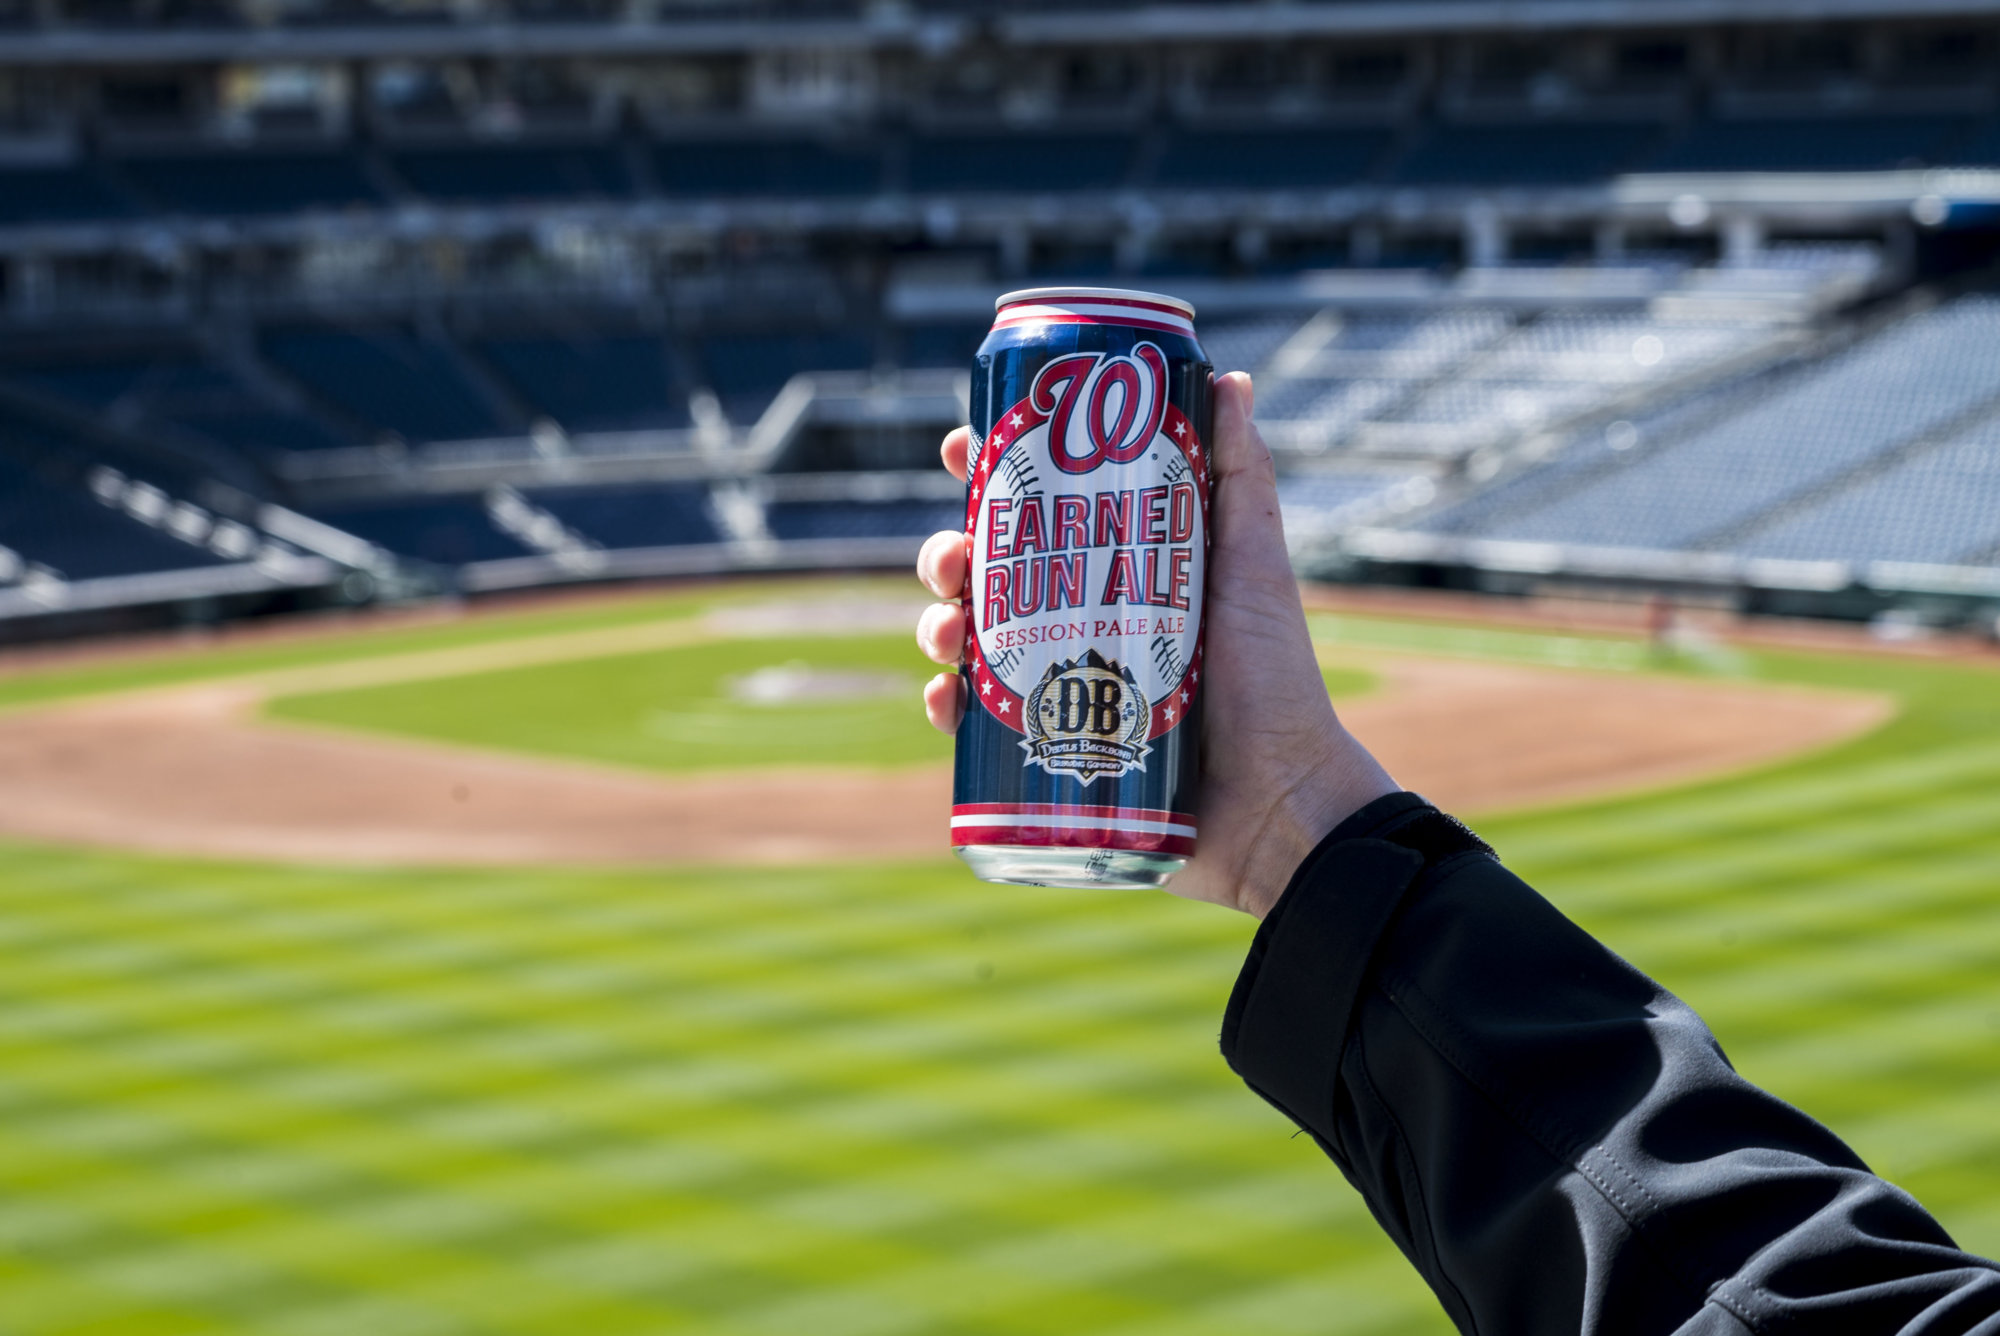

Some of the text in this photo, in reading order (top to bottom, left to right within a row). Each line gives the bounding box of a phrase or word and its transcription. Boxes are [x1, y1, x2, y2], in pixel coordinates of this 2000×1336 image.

[1031, 342, 1168, 475] W
[987, 482, 1194, 562] EARNED
[983, 548, 1192, 632] RUN ALE
[995, 617, 1185, 650] SESSION PALE ALE
[1052, 677, 1121, 735] DB
